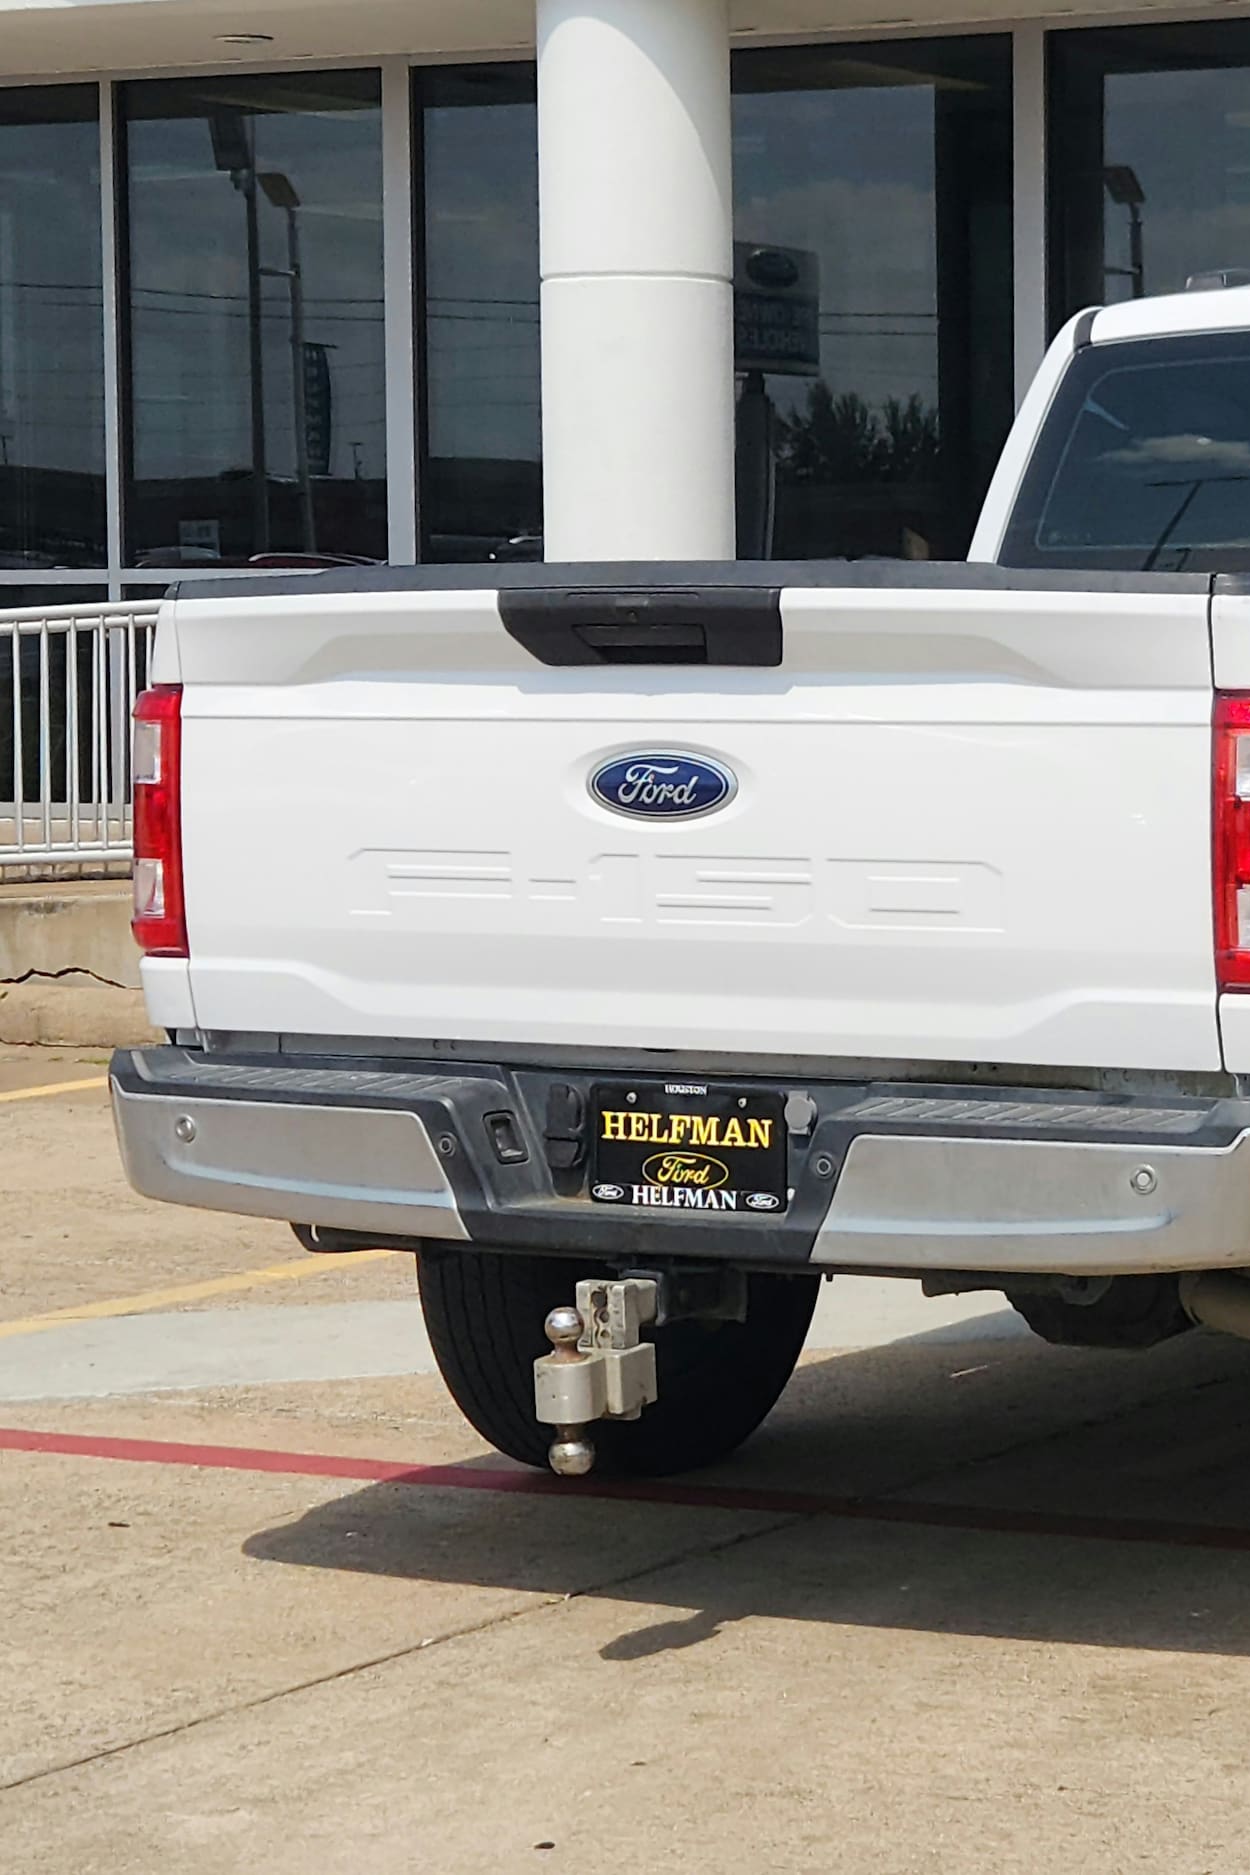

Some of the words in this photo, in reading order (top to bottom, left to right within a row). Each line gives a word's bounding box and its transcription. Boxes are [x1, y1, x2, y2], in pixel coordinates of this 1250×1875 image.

[618, 763, 699, 805] Ford
[664, 1083, 708, 1096] HOUSTON
[601, 1110, 773, 1149] HELFMAN
[657, 1154, 711, 1185] Ford
[631, 1184, 737, 1210] HELFMAN
